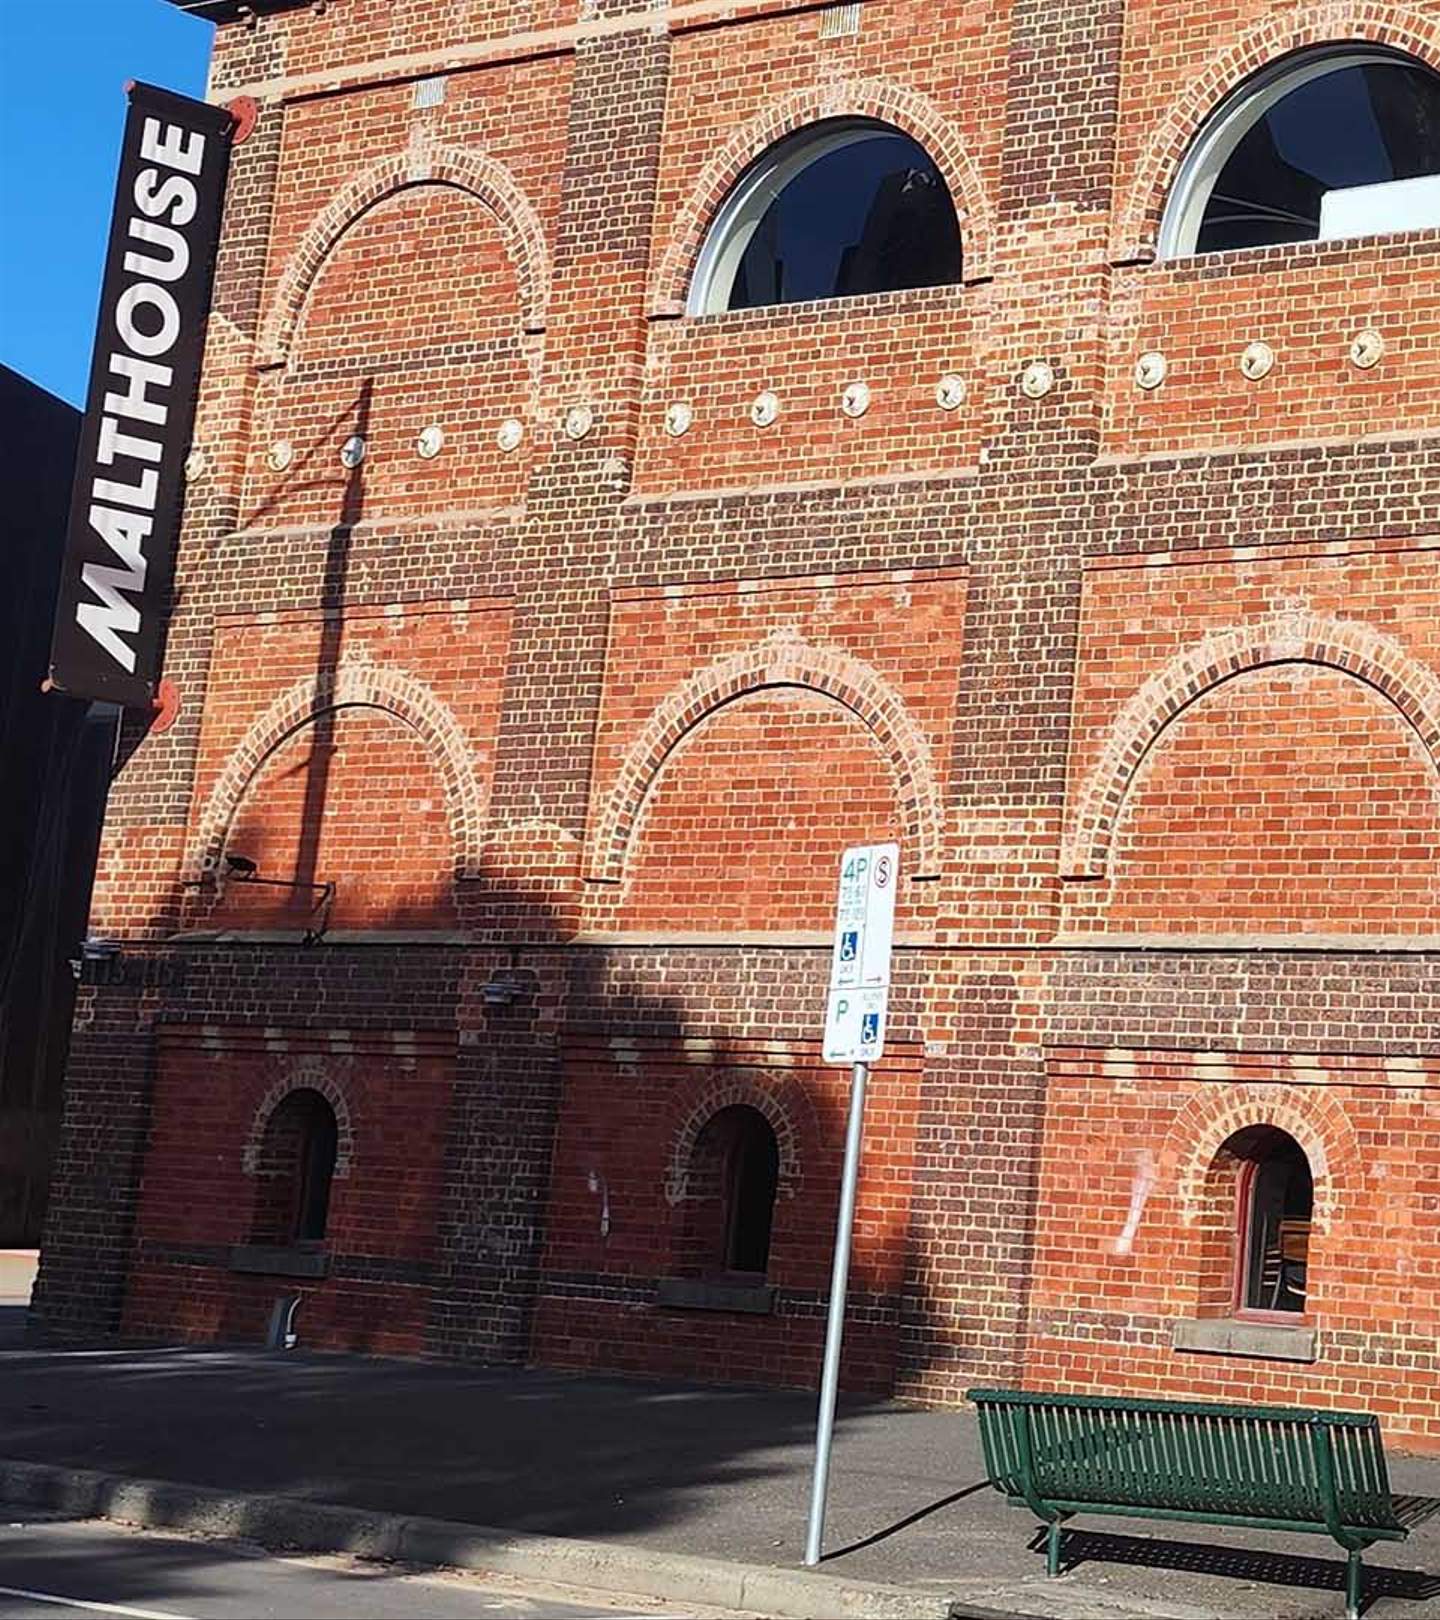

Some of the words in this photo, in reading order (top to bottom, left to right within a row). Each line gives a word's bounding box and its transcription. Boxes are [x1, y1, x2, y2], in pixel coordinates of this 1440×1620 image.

[76, 116, 206, 674] MALTHOUSE
[843, 857, 868, 883] 4P
[835, 999, 849, 1024] P
